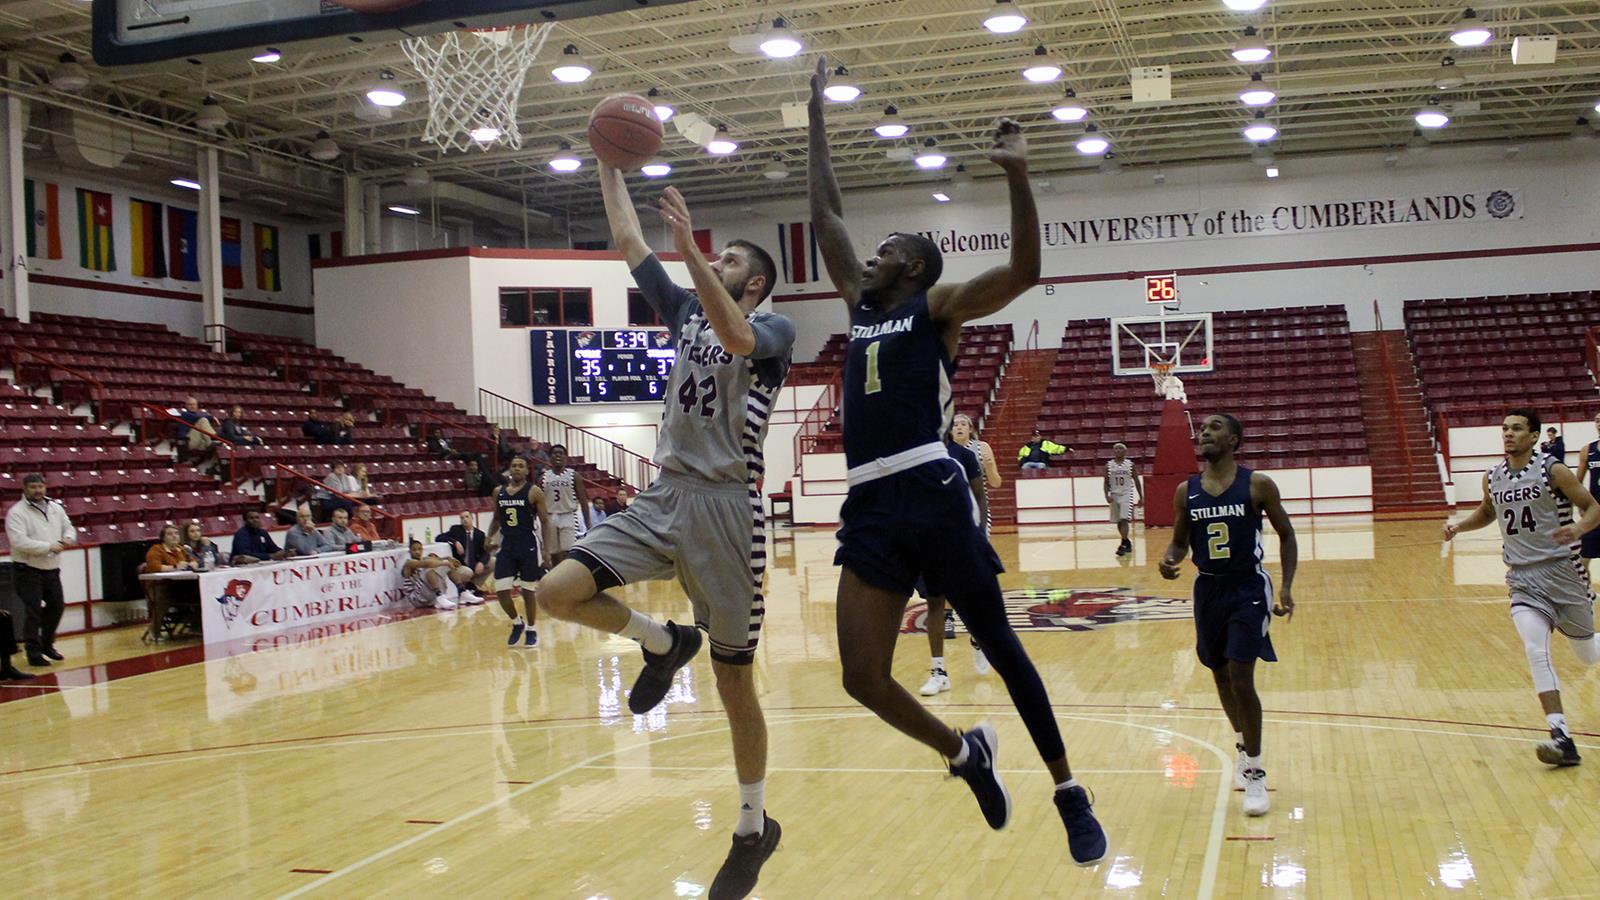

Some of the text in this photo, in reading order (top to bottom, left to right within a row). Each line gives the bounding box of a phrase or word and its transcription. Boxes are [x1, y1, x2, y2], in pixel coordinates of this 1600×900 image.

[1044, 194, 1477, 246] UNIVERSITY of the CUMBERLANDS
[1045, 285, 1055, 296] B
[1148, 278, 1175, 300] 26
[850, 315, 914, 341] STILLMAN
[614, 331, 647, 348] 5:39
[680, 338, 734, 367] TGERS
[545, 331, 557, 404] PATRIOTS
[582, 359, 601, 376] 35
[864, 341, 881, 395] 1
[583, 382, 657, 395] 7 5 6
[678, 371, 717, 417] 42
[1115, 476, 1125, 486] 10
[554, 489, 561, 502] 3
[1493, 486, 1541, 505] TIGERS
[506, 508, 518, 526] 3
[1190, 504, 1245, 521] STILLMAN
[1504, 506, 1537, 536] 24
[1207, 522, 1230, 559] 2
[272, 555, 399, 586] UNIVERSITY
[321, 578, 361, 594] OF THE
[251, 588, 405, 626] CUMBERLAND
